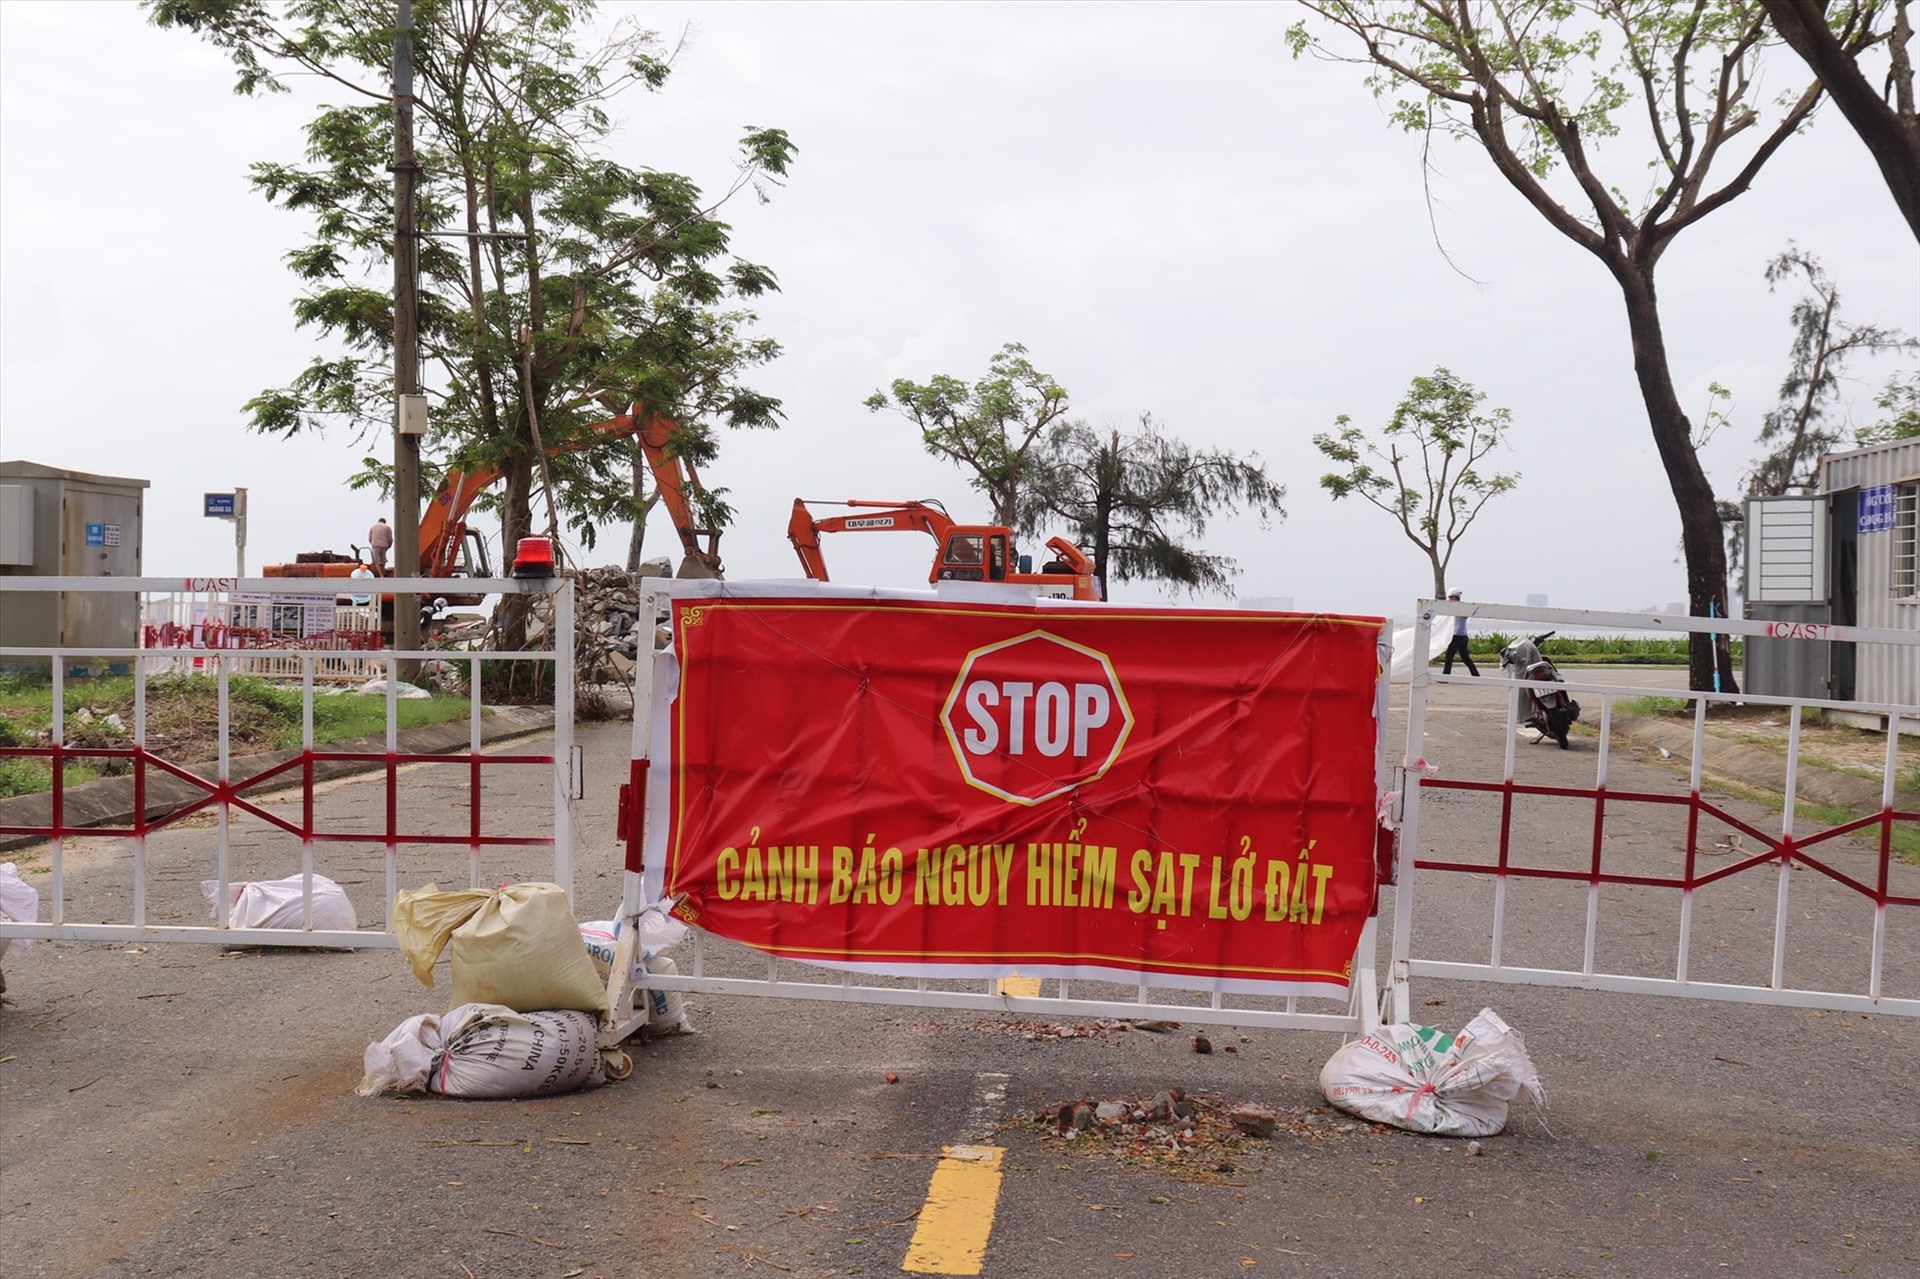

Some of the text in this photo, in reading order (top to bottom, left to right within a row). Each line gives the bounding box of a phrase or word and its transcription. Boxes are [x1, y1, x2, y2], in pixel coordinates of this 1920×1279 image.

[964, 680, 1110, 757] STOP
[717, 818, 1335, 930] CẢNH BÁO NGUY HIỂM SẠT LỞ ĐẤT
[521, 1030, 545, 1071] CHINA
